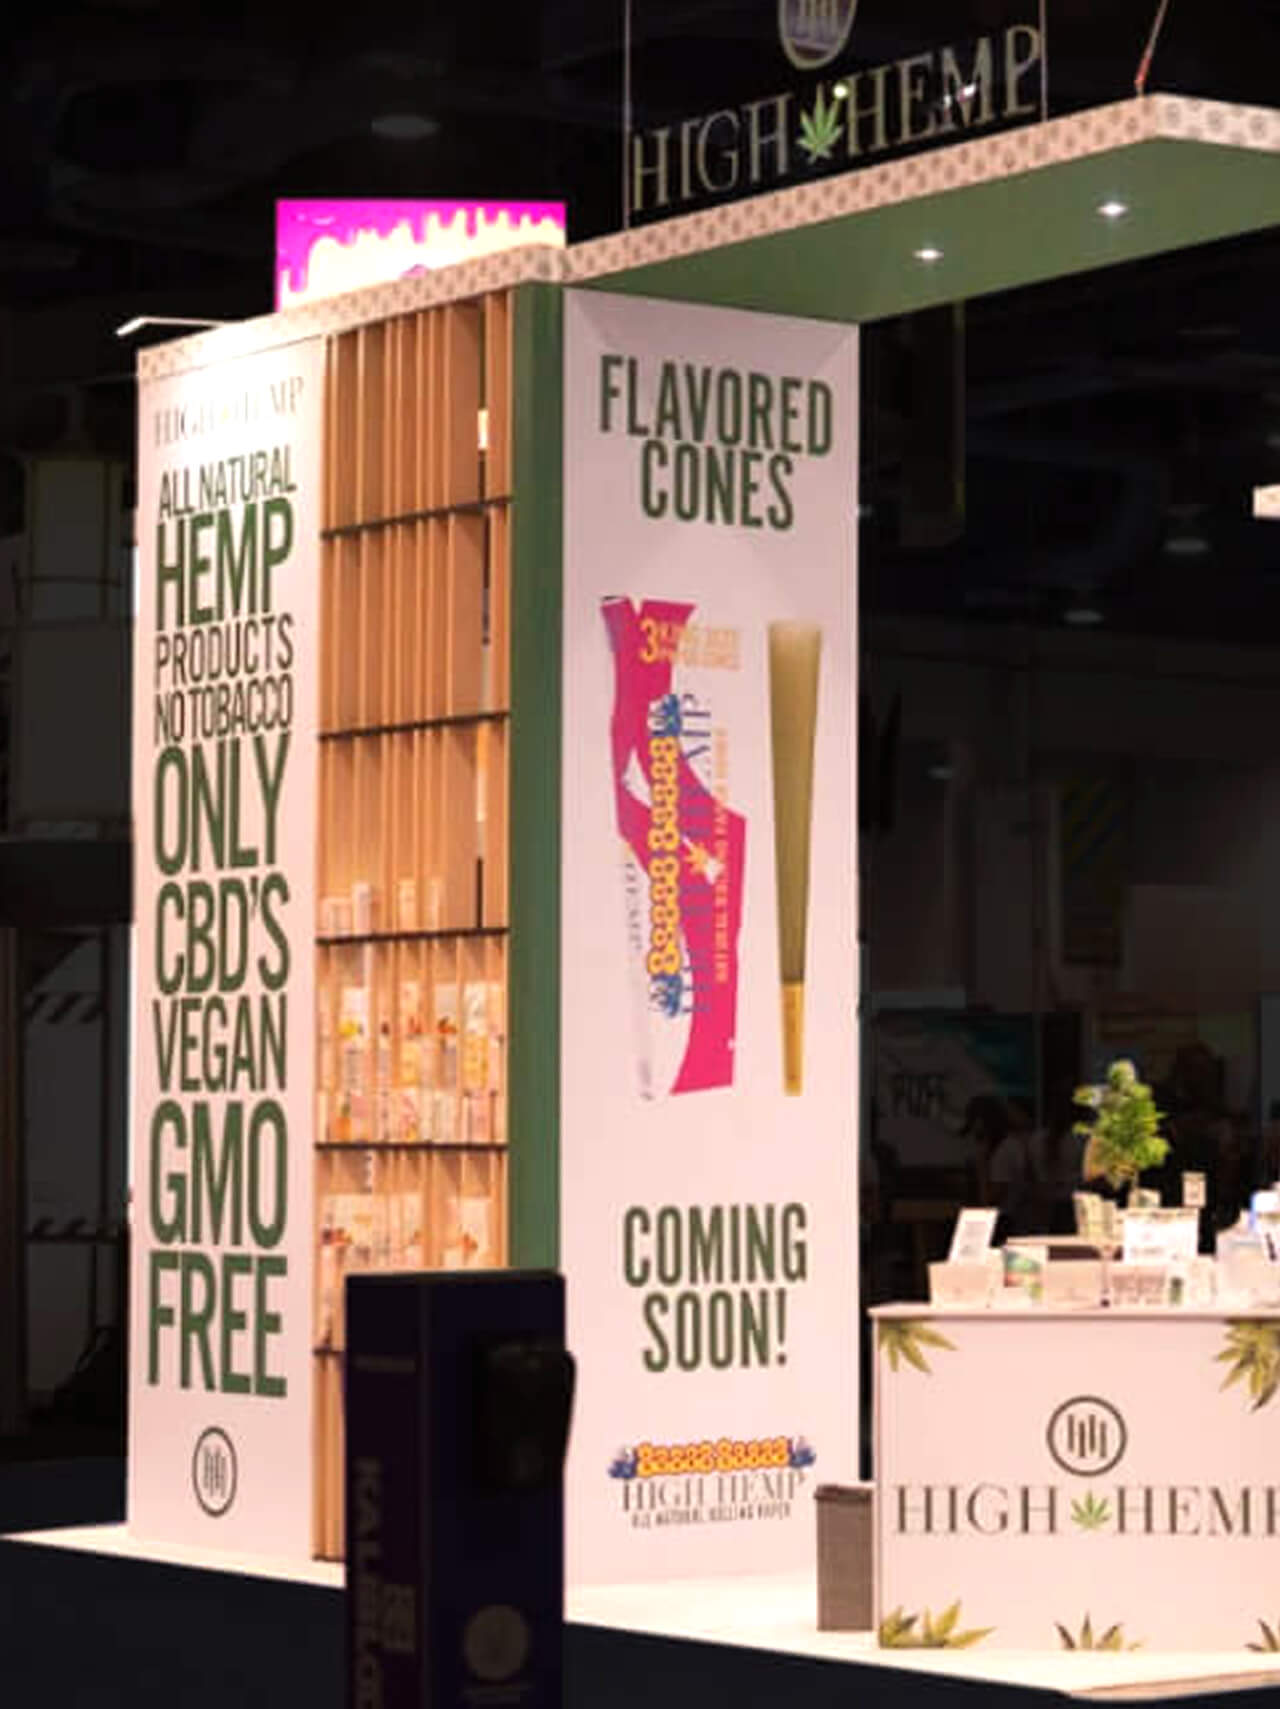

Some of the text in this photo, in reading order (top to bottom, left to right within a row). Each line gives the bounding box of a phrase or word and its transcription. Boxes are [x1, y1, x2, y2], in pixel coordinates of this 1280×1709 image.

[632, 24, 1041, 212] HIGH HEMP
[600, 354, 832, 456] FLAVORED
[158, 444, 297, 519] ALL NATURAL
[641, 439, 794, 531] CONES
[155, 497, 294, 631] HEMP
[154, 612, 294, 689] PRODUCTS
[154, 673, 294, 747] NO TOBACCO
[153, 731, 291, 876] ONLY
[155, 872, 291, 995] CBD'S
[153, 994, 287, 1093] VEGAN
[148, 1097, 288, 1249] GMO
[623, 1202, 807, 1287] COMING
[148, 1250, 287, 1398] FREE
[642, 1287, 788, 1373] SOON!
[623, 1471, 806, 1512] HIGH HEMP
[894, 1484, 1059, 1537] HIGH
